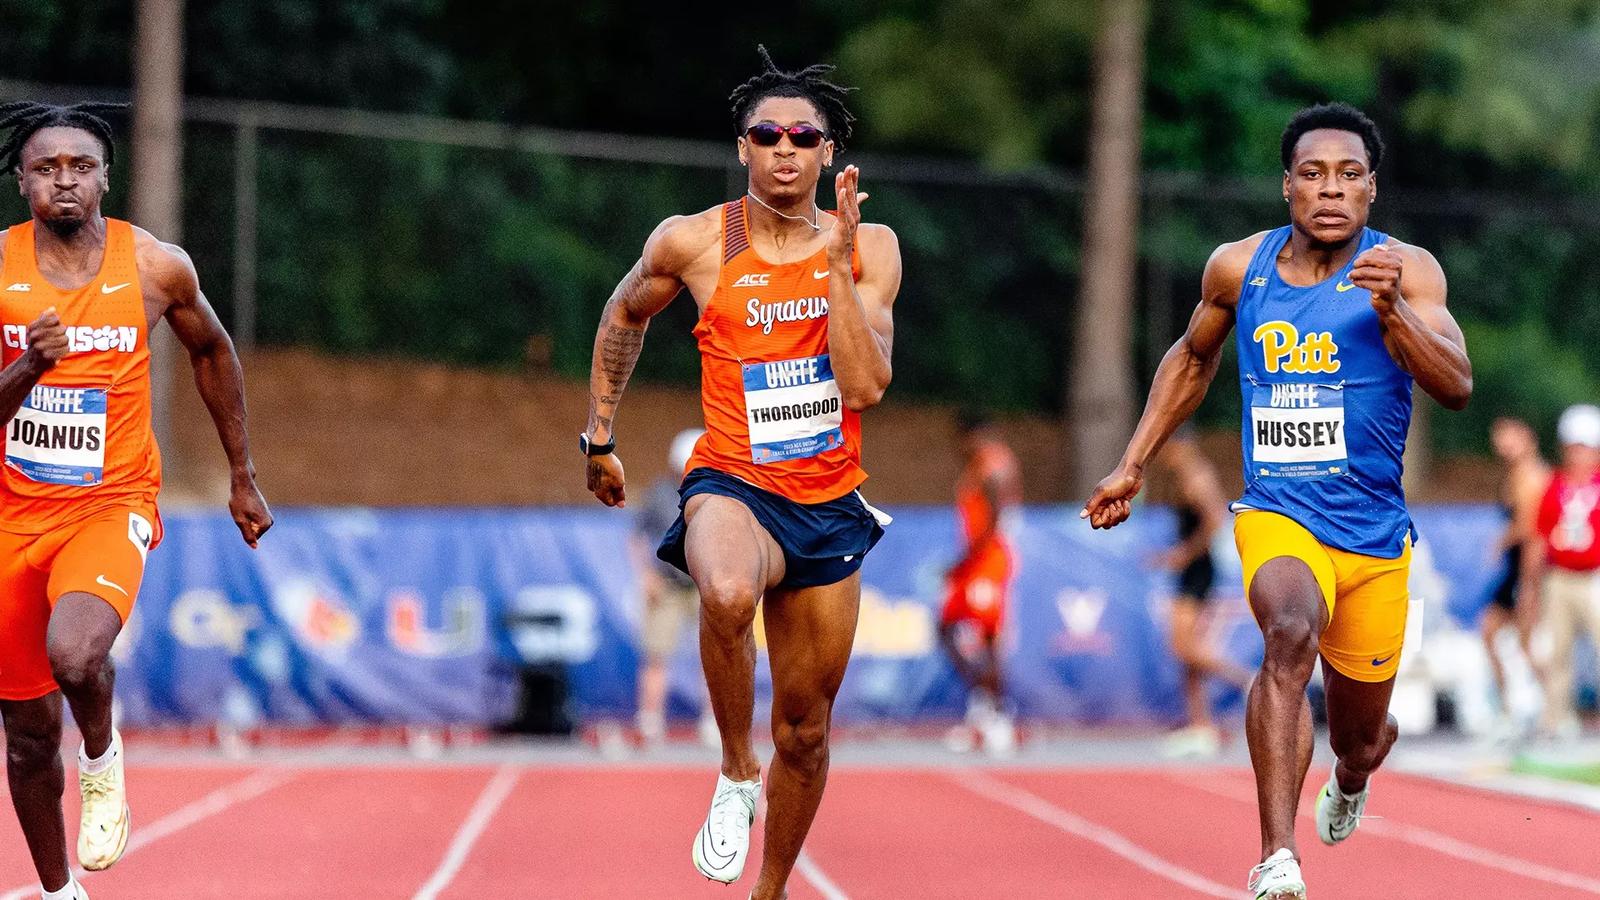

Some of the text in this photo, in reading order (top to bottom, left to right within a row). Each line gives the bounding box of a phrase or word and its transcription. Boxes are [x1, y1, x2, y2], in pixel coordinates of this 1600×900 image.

[734, 273, 771, 285] ACC
[746, 297, 829, 335] Syracus
[1253, 320, 1341, 374] Pitt
[764, 358, 820, 388] UNITE
[31, 386, 85, 414] UNITE
[751, 397, 839, 424] THOROGOOD
[11, 418, 100, 452] JOANUS
[1257, 420, 1340, 448] HUSSEY
